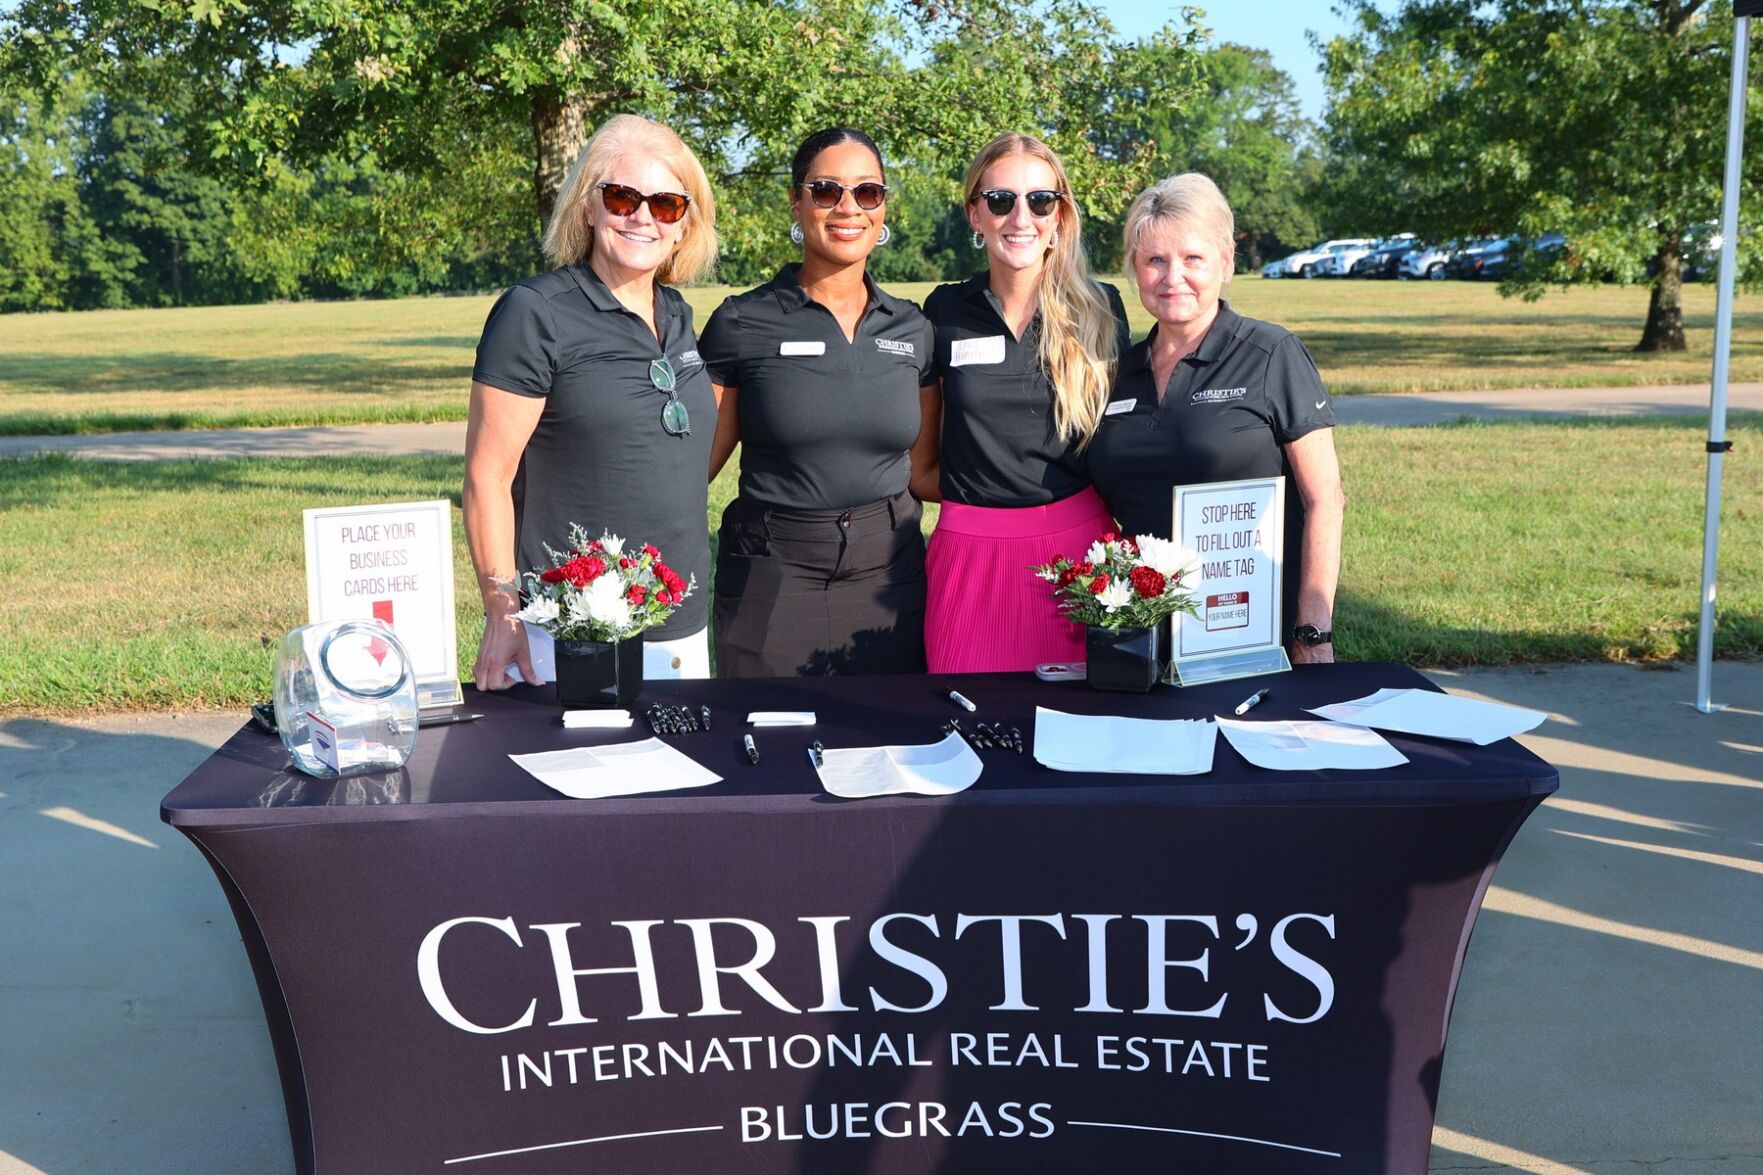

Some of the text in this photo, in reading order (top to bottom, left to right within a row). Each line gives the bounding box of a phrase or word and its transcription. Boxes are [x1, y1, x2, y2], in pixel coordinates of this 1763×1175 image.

[1202, 502, 1256, 524] STOP HERE
[341, 522, 416, 544] PLACE YOUR
[1195, 529, 1262, 553] TO FILL OUT A
[350, 549, 408, 570] BUSINESS
[1202, 557, 1255, 580] NAME TAG
[344, 574, 419, 597] CARDS HERE
[1217, 593, 1238, 602] HELLO
[1220, 610, 1234, 620] NAME
[1235, 609, 1247, 618] HERE
[416, 912, 1336, 1035] CHRISTIE'S
[501, 1032, 1271, 1092] INTERNATIONAL REAL ESTATE
[740, 1101, 1056, 1143] BLUEGRASS
